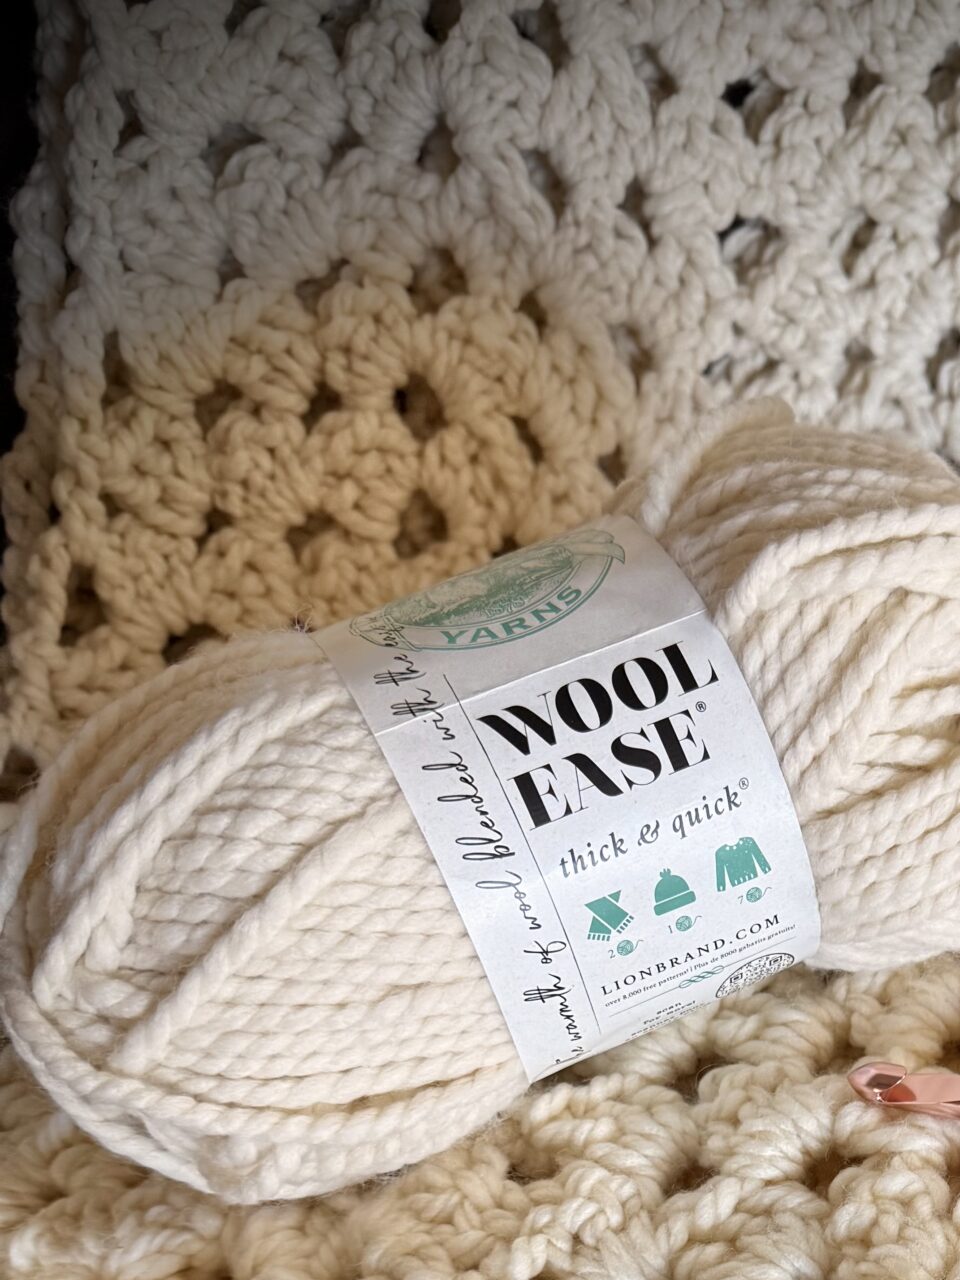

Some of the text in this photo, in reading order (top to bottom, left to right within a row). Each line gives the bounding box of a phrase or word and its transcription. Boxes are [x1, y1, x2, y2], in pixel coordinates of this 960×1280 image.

[440, 585, 582, 645] YARNS
[373, 653, 427, 687] the
[476, 640, 720, 756] WOOL
[390, 687, 456, 741] with
[421, 750, 516, 861] blended
[558, 832, 628, 879] thick
[637, 820, 661, 845] &
[475, 870, 542, 930] wool
[523, 940, 567, 964] of
[601, 913, 780, 995] LIONBRAND.COM
[608, 949, 616, 959] 2
[523, 973, 583, 1042] warmth
[604, 997, 621, 1008] over
[642, 982, 657, 993] free
